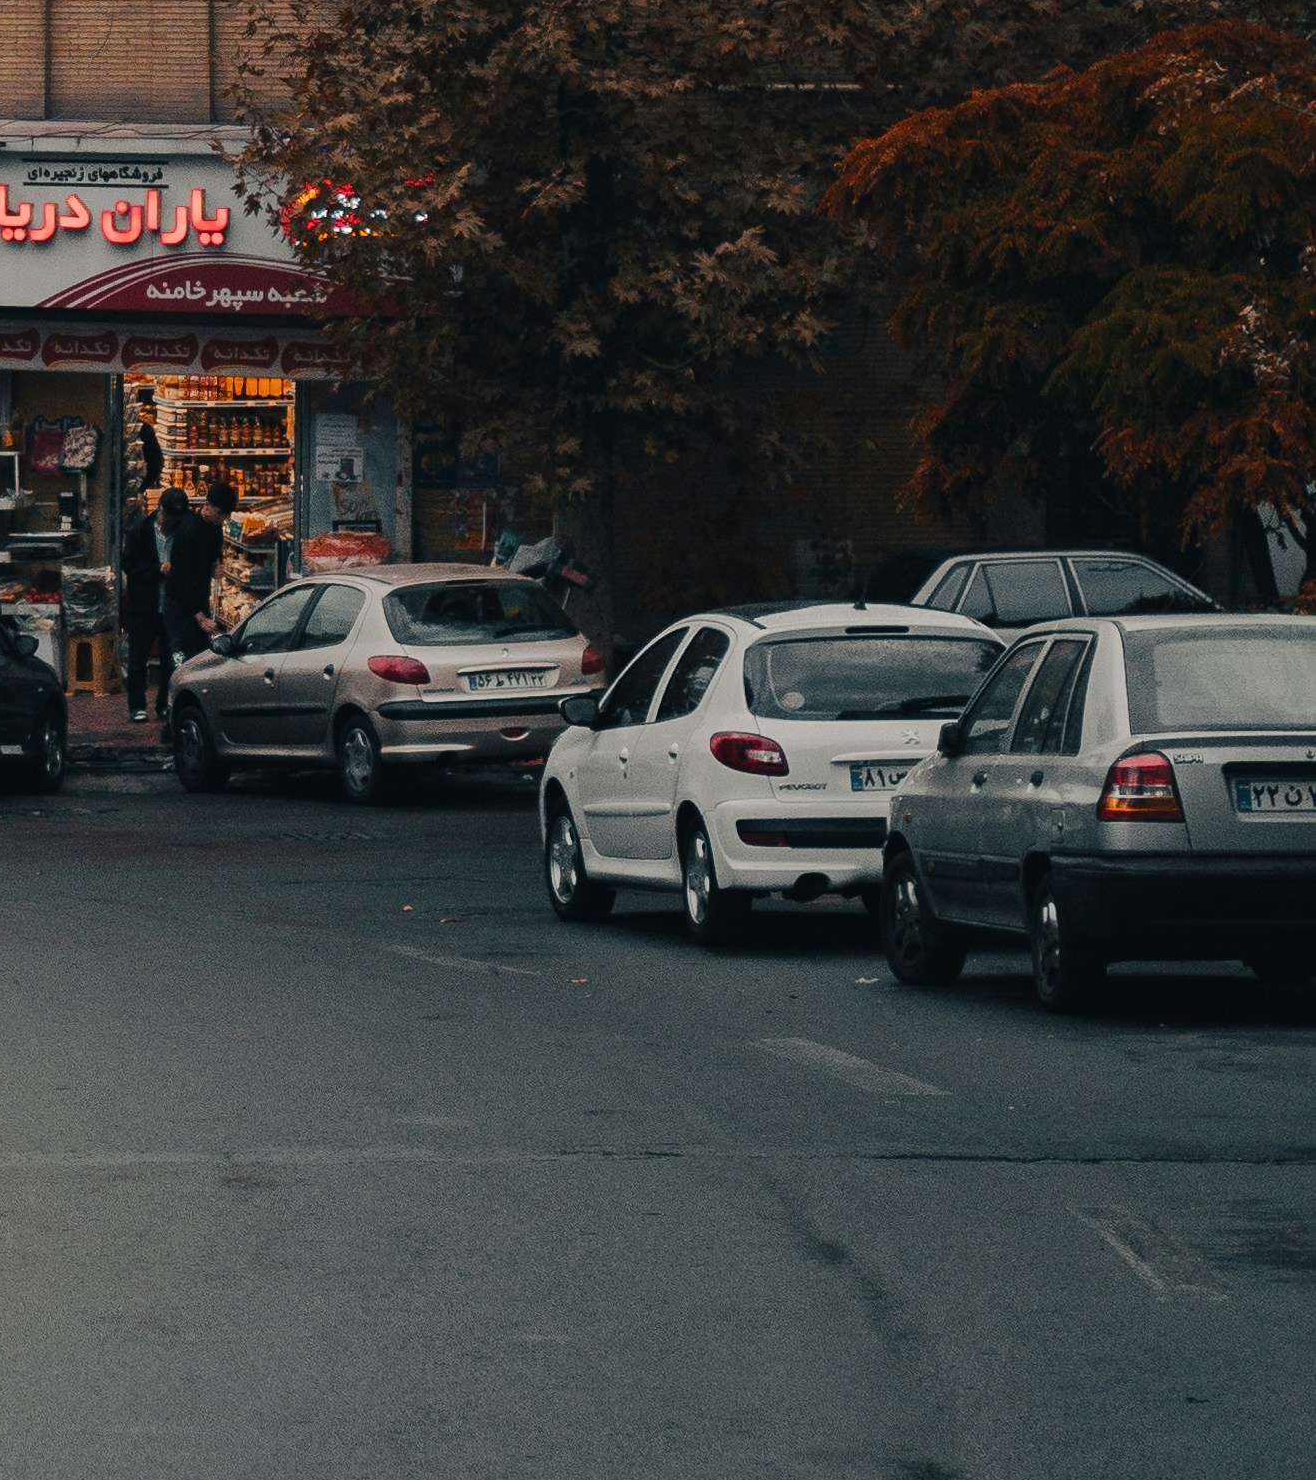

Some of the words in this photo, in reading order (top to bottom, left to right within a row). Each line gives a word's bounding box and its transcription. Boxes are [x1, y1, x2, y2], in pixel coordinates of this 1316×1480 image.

[100, 188, 230, 246] یاران
[146, 280, 207, 300] خامنه
[206, 287, 264, 311] سپهر
[865, 769, 886, 787] ۸۱
[1252, 784, 1279, 808] ۲۲
[1284, 786, 1303, 807] ن
